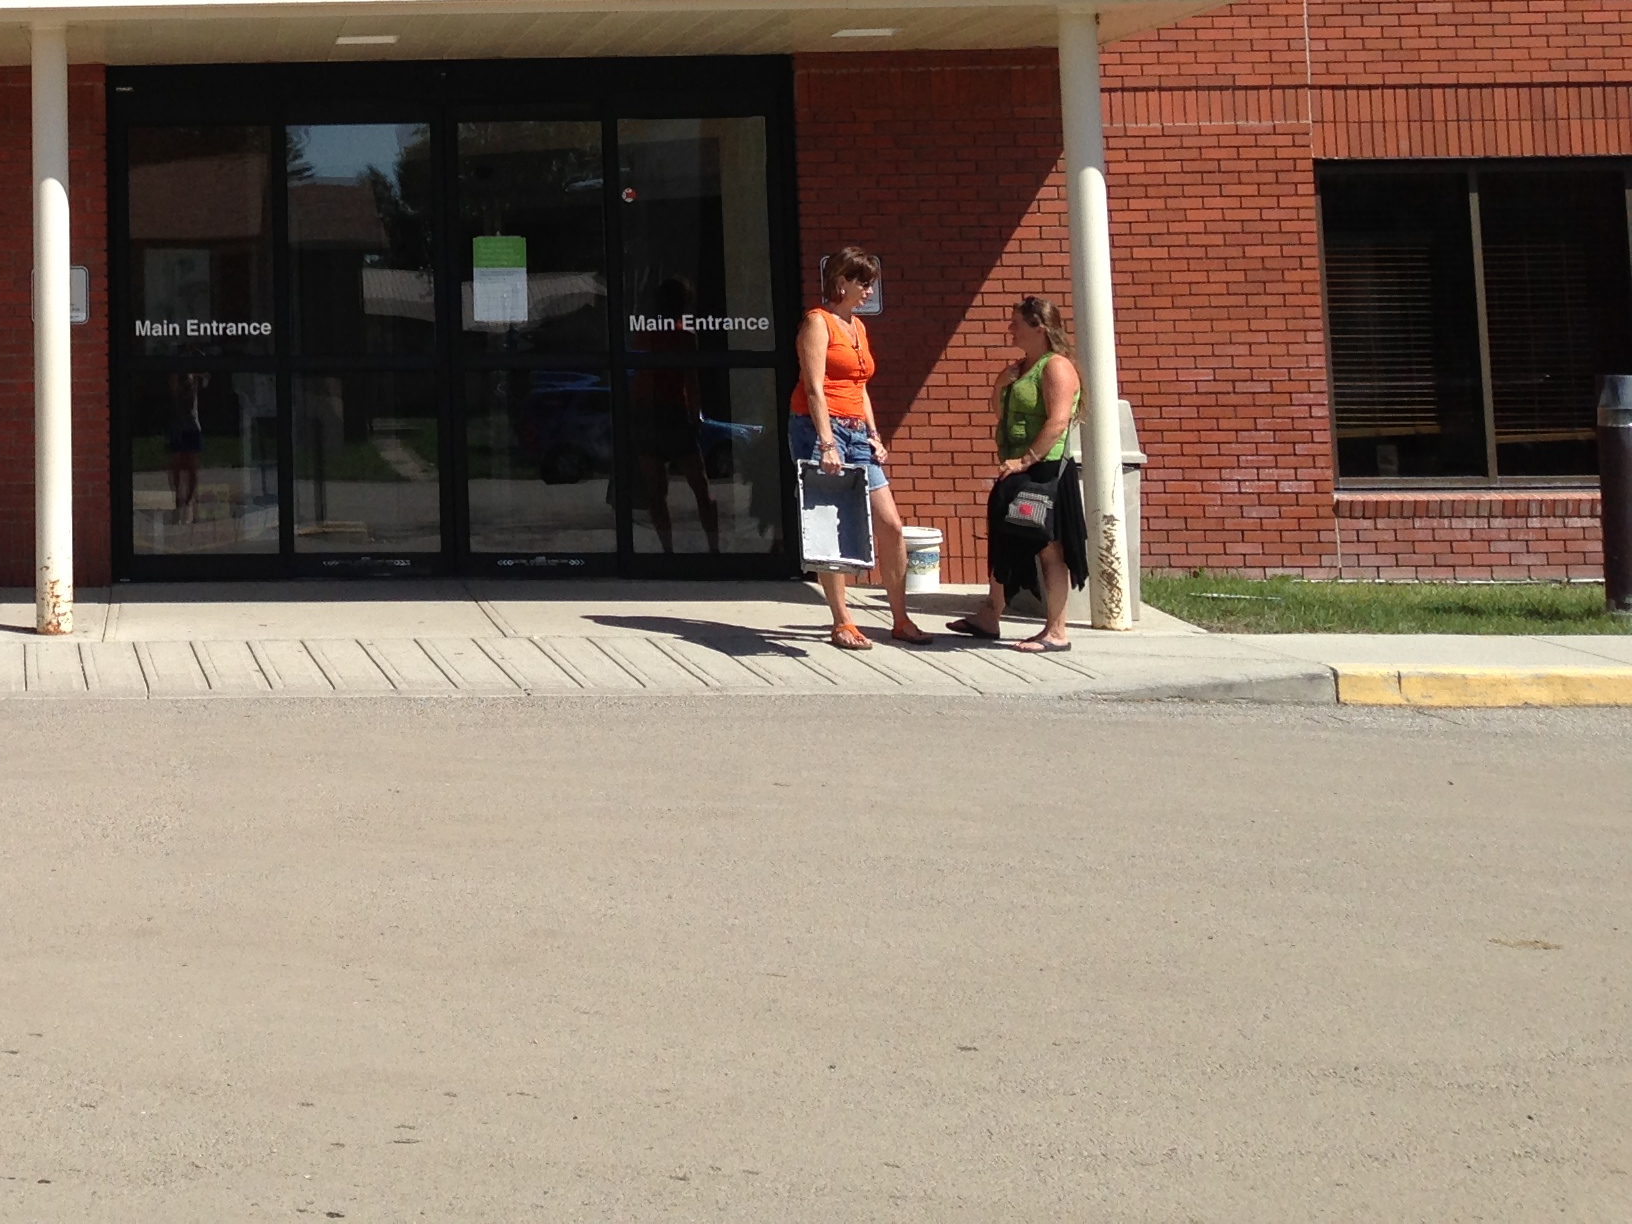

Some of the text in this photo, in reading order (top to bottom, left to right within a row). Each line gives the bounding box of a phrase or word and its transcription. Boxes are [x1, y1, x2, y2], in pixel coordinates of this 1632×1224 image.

[135, 319, 272, 337] Main Entrance
[629, 314, 770, 332] Main Entrance
